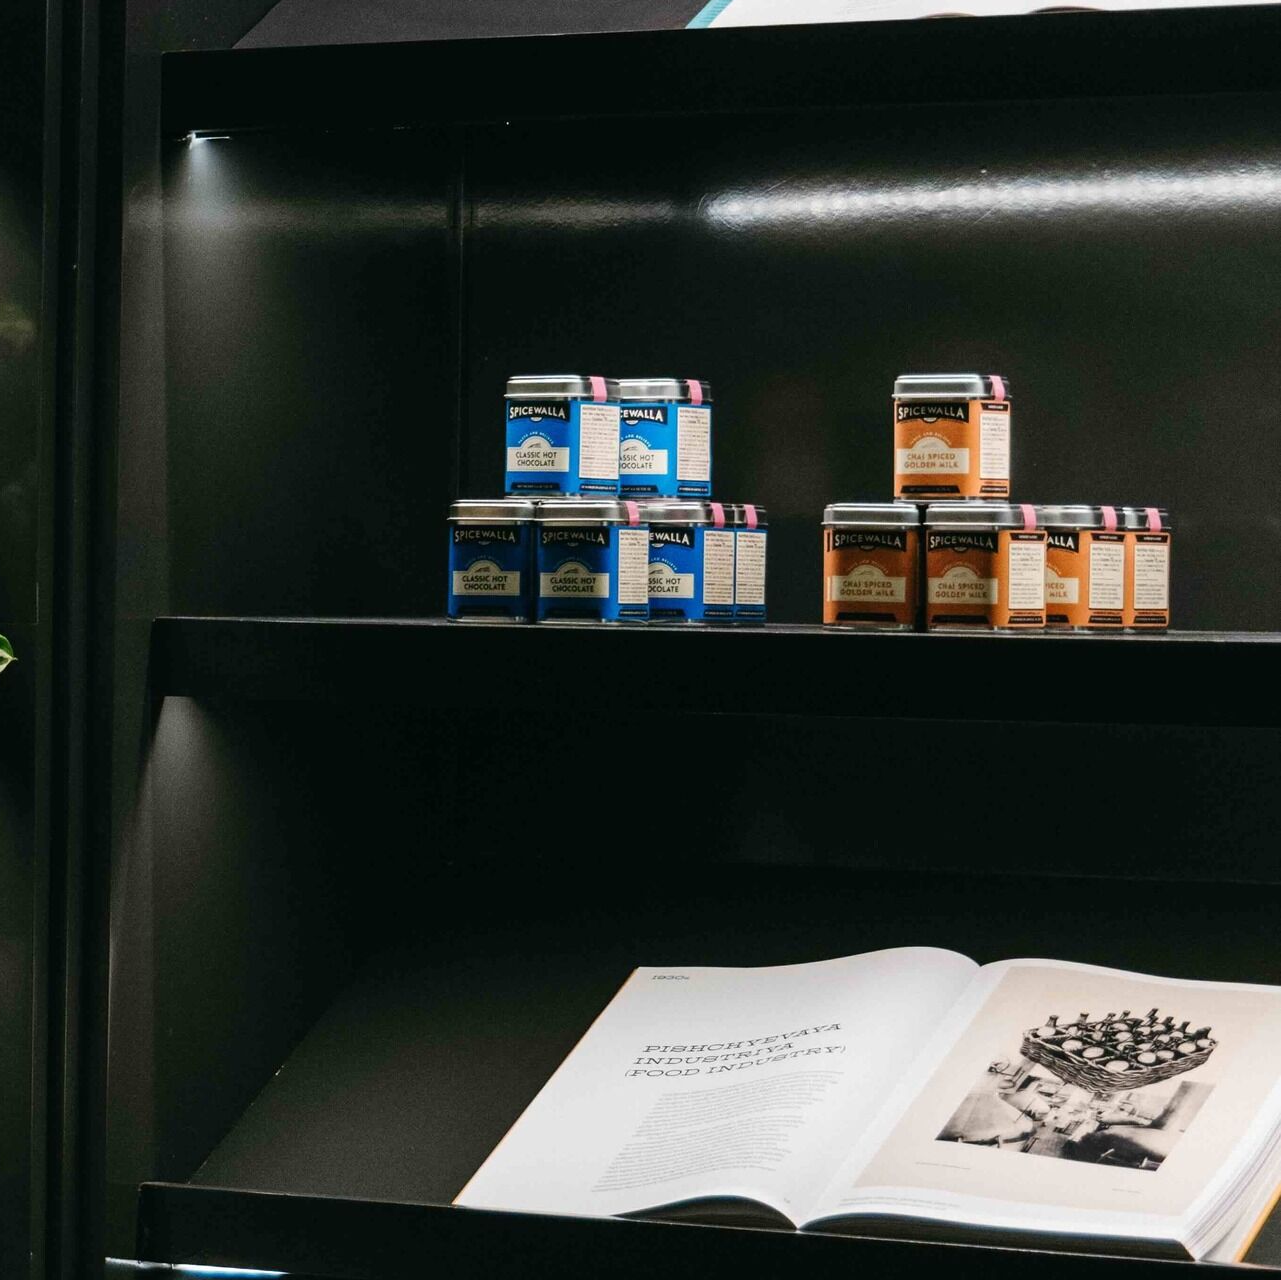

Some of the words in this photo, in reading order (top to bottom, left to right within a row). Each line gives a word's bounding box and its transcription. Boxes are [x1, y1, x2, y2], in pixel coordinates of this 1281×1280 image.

[509, 405, 566, 420] SPICEWALLA
[898, 406, 965, 420] SPICEWALLA
[515, 451, 540, 459] CLASSIC
[543, 451, 557, 459] HOT
[907, 452, 925, 461] CHAI
[928, 452, 956, 460] SPICED
[517, 459, 555, 467] CHOCOLATE
[904, 461, 936, 469] GOLDEN
[939, 461, 959, 469] MILK
[454, 530, 516, 543] SPICEWALLA
[542, 531, 605, 545] SPICEWALLA
[834, 534, 902, 547] SPICEWALLA
[929, 535, 994, 548] SPICEWALLA
[1047, 535, 1075, 549] ALLA
[462, 575, 490, 583] CLASSIC
[492, 575, 508, 583] HOT
[549, 577, 578, 585] CLASSIC
[580, 577, 597, 585] HOT
[842, 580, 862, 588] CHAI
[463, 583, 506, 591] CHOCOLATE
[551, 584, 595, 593] CHOCOLATE
[875, 589, 895, 597] MILK
[642, 1023, 842, 1053] PISHCHYEVAYA
[632, 1042, 795, 1065] INDUSTRIYA
[624, 1068, 700, 1078] (FOOD
[705, 1045, 847, 1075] INDUSTRY)
